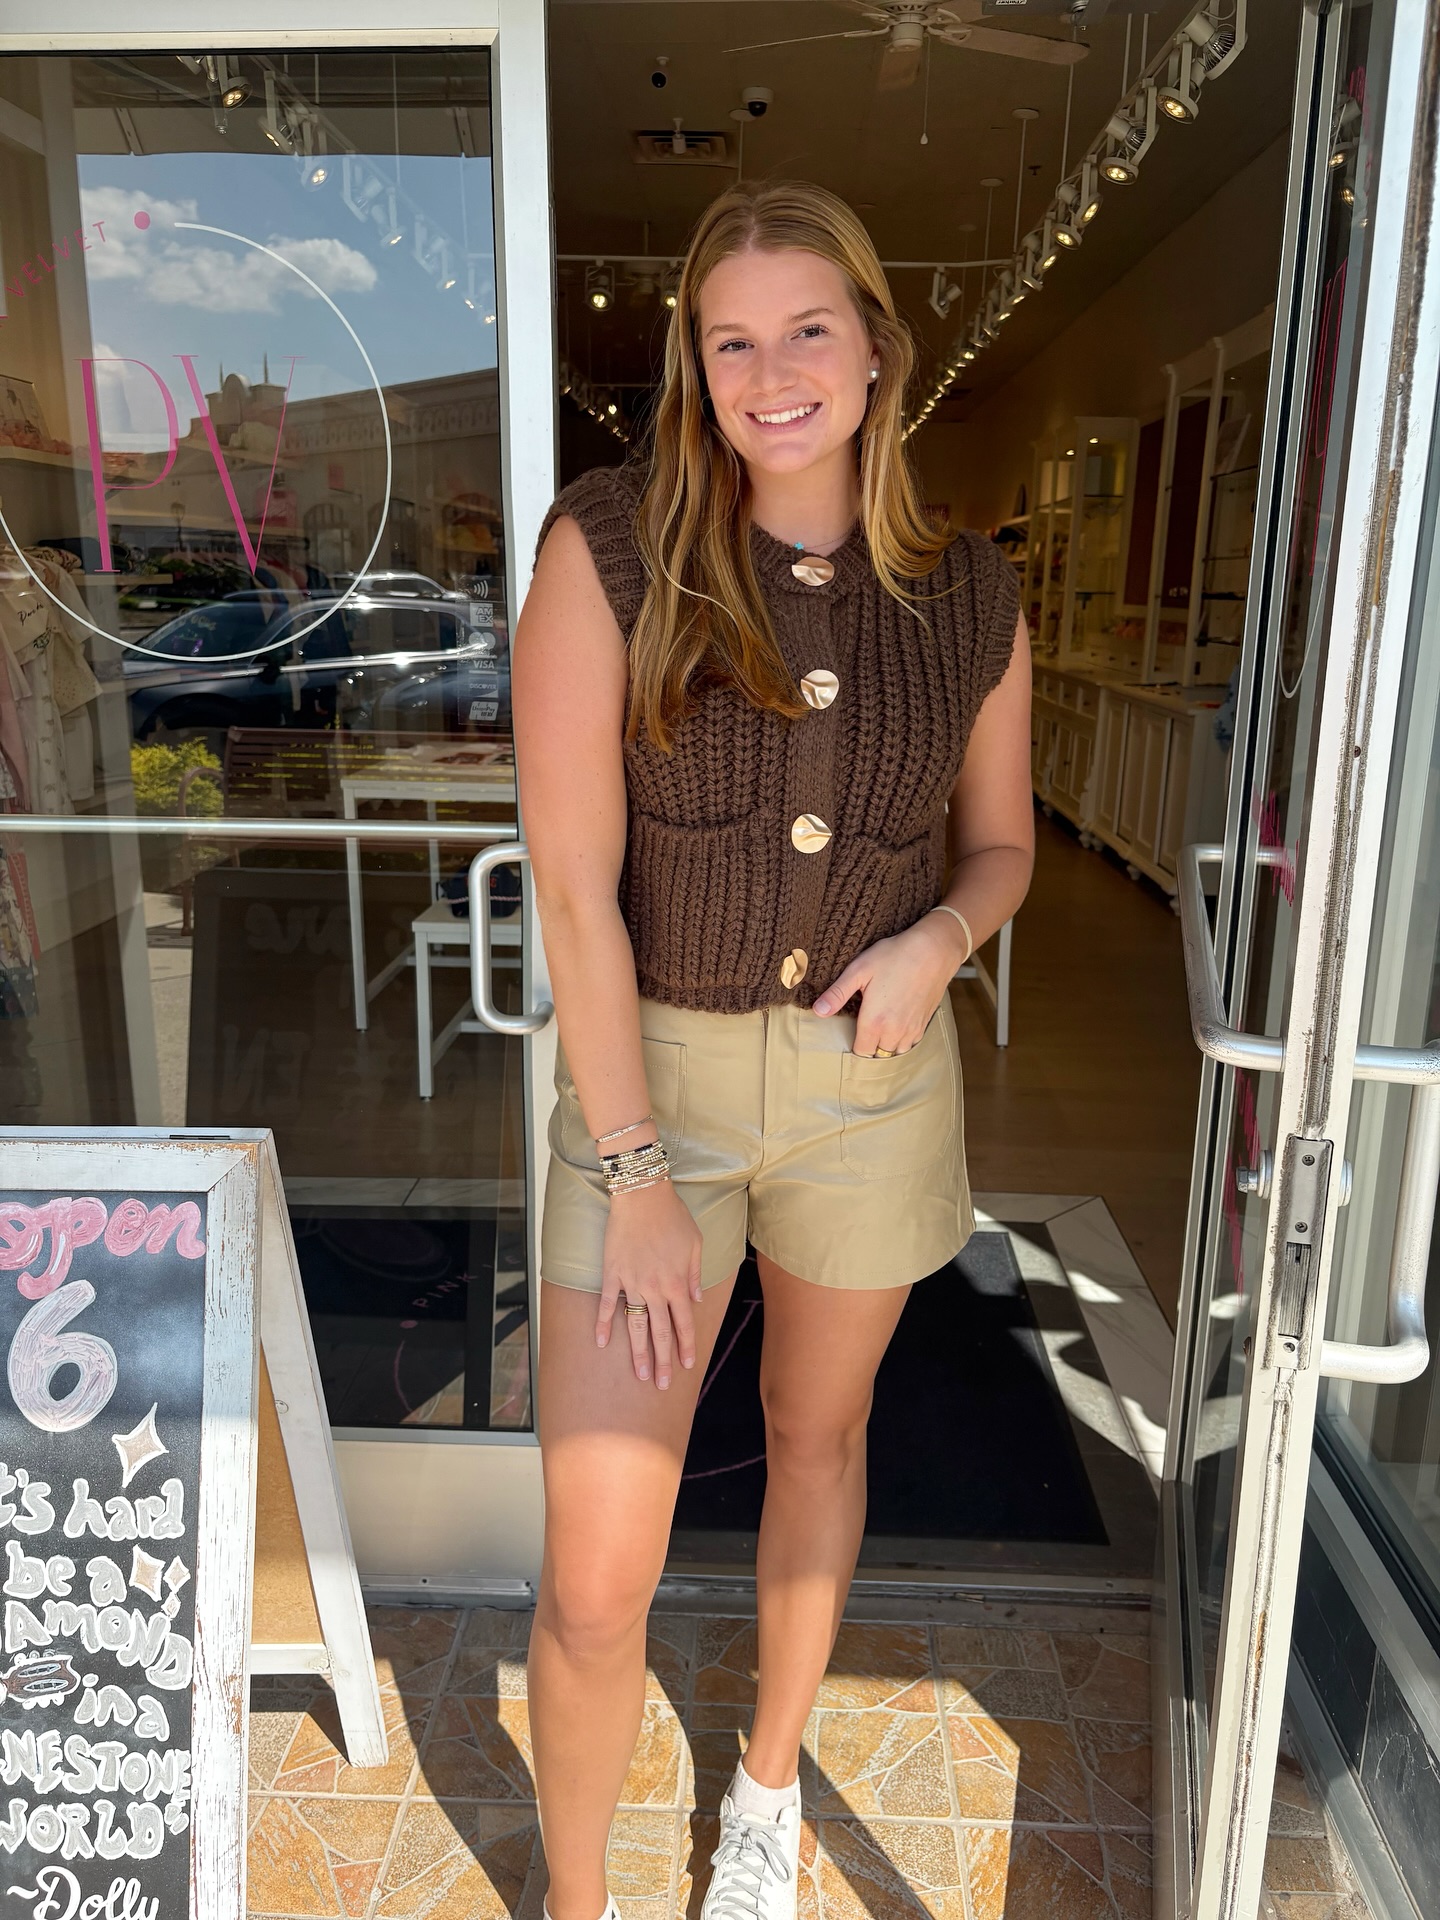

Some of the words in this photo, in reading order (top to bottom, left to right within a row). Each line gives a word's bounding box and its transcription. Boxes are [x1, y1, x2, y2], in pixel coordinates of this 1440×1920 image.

[4, 221, 106, 298] VELVET
[74, 354, 307, 576] PV
[473, 660, 495, 670] VISA
[8, 1279, 118, 1432] 6
[63, 1478, 186, 1541] hard
[3, 1540, 76, 1599] be
[86, 1555, 128, 1607] a
[0, 1600, 194, 1690] AMOND
[73, 1673, 138, 1727] in
[134, 1695, 170, 1742] a
[0, 1729, 191, 1802] NESTONE
